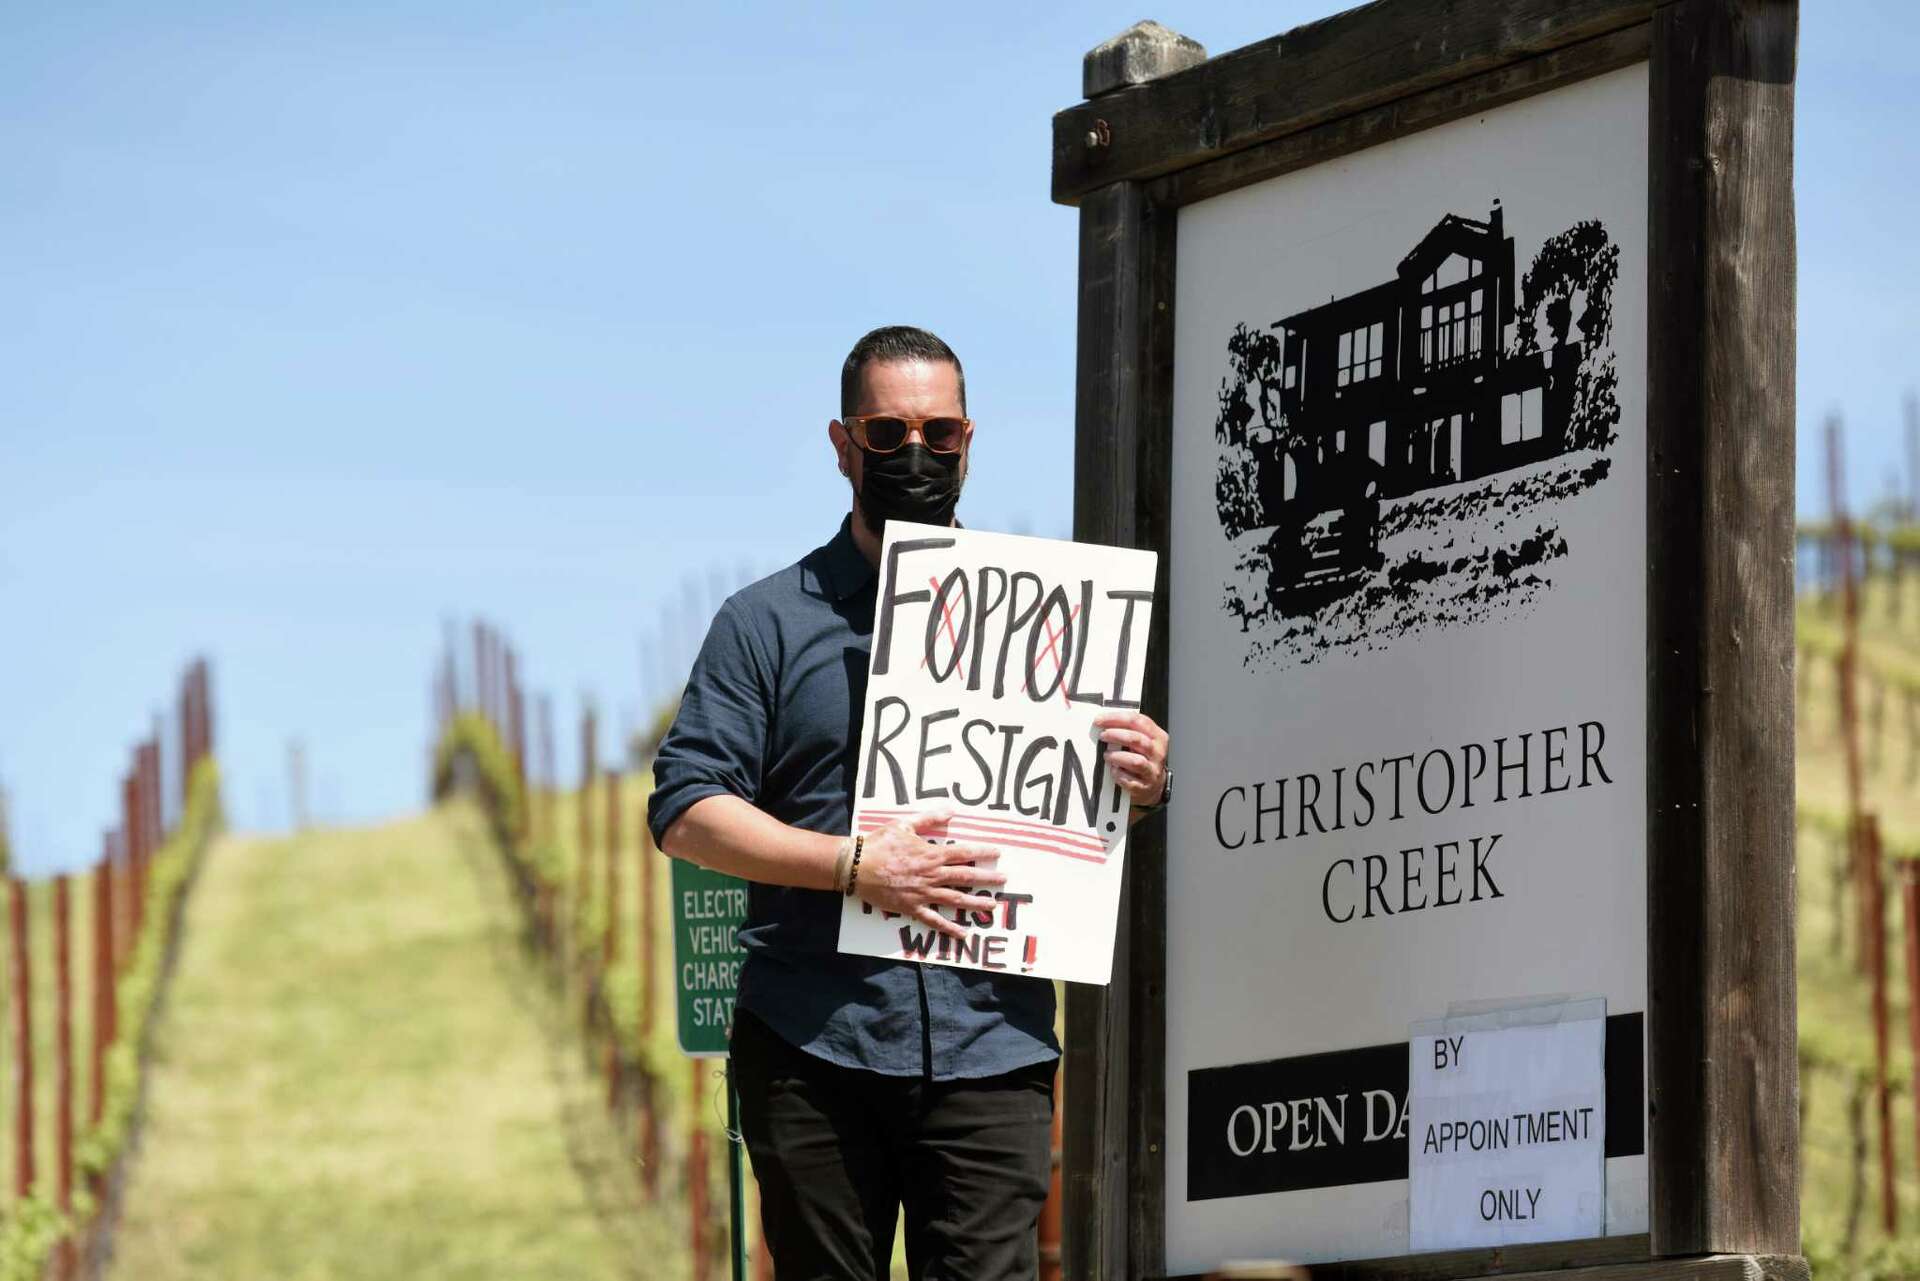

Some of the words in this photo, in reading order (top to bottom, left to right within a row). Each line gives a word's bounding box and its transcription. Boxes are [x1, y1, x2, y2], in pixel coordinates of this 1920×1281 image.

[872, 538, 1154, 709] FOPPOLI
[1214, 720, 1613, 850] CHRISTOPHER
[1322, 833, 1505, 924] CREEK
[683, 960, 744, 991] CHARG
[693, 997, 737, 1027] STAT
[1434, 1035, 1464, 1070] BY
[1226, 1093, 1349, 1157] OPEN
[1423, 1107, 1594, 1155] APPOINTMENT
[1480, 1188, 1542, 1221] ONLY
